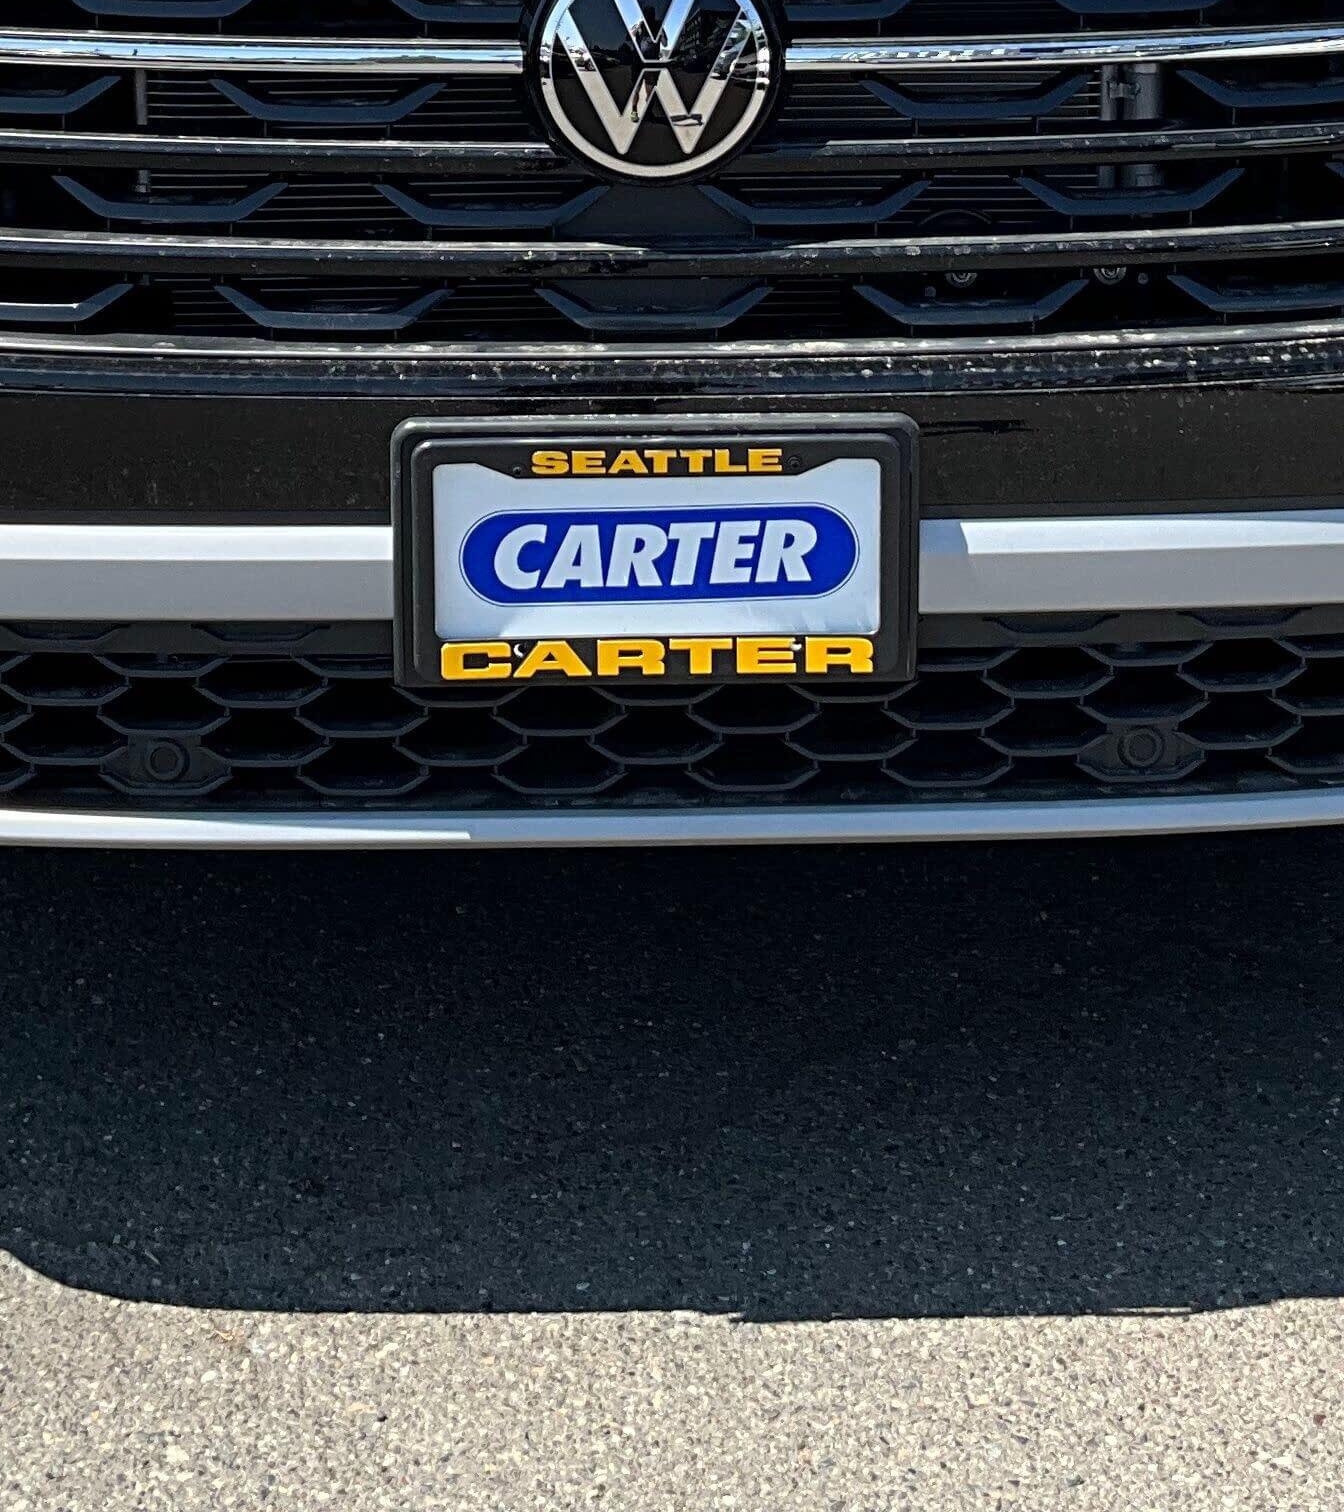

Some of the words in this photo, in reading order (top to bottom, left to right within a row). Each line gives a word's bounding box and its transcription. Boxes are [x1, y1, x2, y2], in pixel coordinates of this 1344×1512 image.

[531, 448, 783, 475] SEATTLE
[494, 519, 818, 590] CARTER
[440, 637, 874, 681] CARTER
